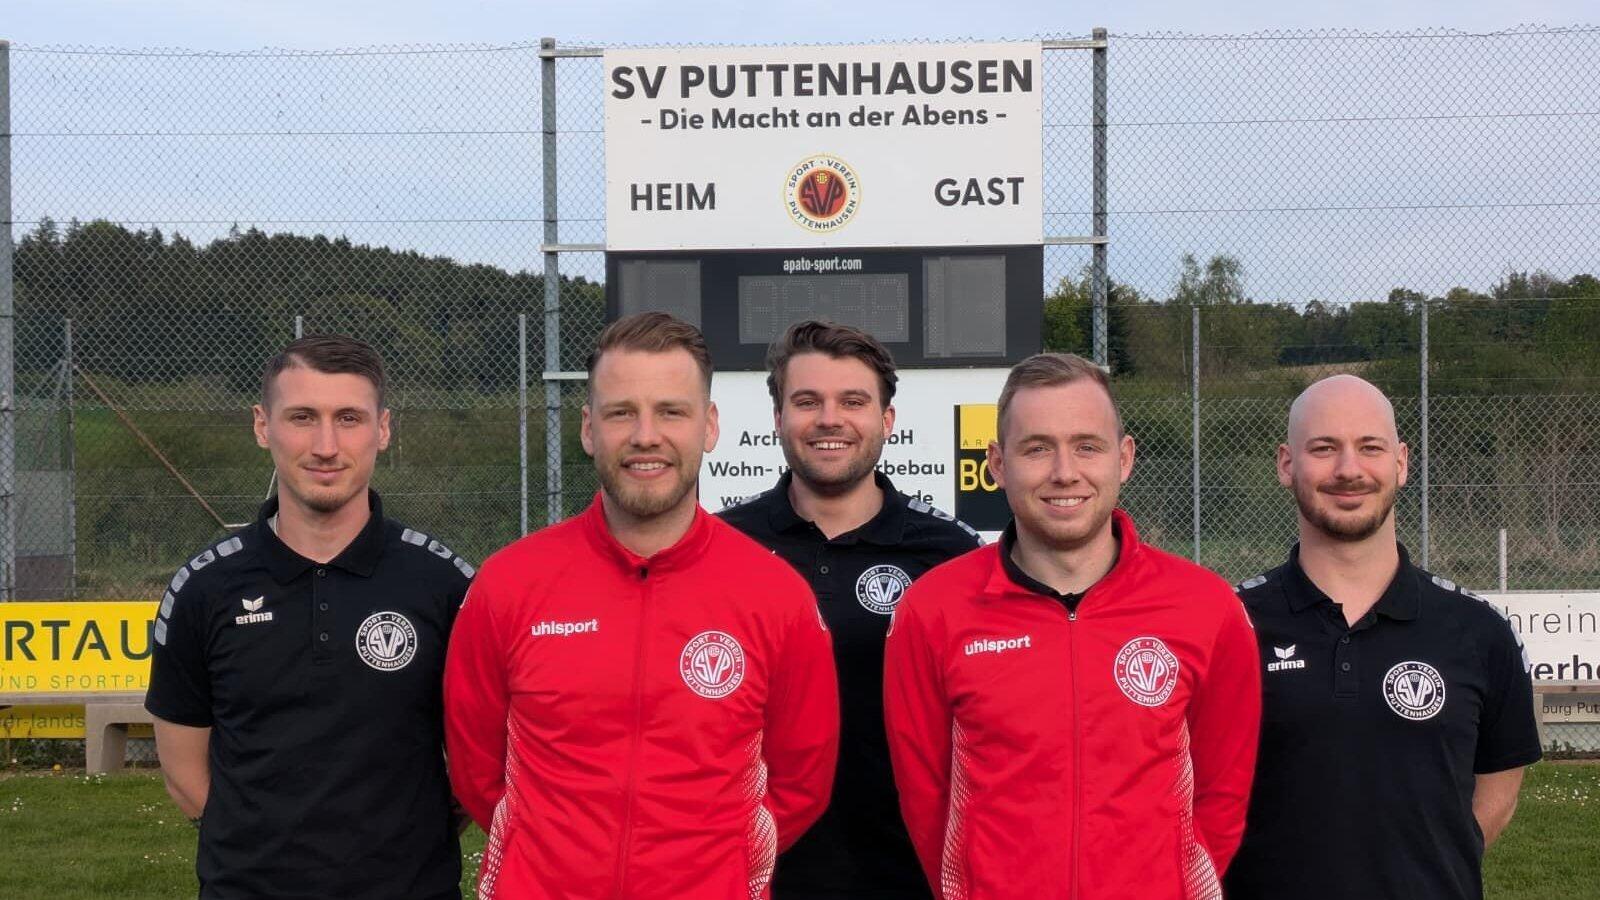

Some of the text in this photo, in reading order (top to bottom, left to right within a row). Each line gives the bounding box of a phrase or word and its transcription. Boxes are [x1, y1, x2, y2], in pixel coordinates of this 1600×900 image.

[611, 59, 1033, 99] SV PUTTENHAUSEN
[659, 108, 704, 130] Die
[711, 106, 799, 129] Macht
[806, 111, 839, 128] an
[848, 105, 895, 126] der
[901, 104, 989, 126] Abens
[789, 160, 815, 188] SPORT
[827, 159, 857, 189] VEREIN
[630, 183, 717, 211] HEIM
[800, 172, 844, 216] SVP
[934, 177, 1025, 206] GAST
[789, 200, 857, 229] PUTTENHAUSEN
[783, 256, 862, 274] apato-sport.com
[708, 461, 773, 477] Wohn-
[869, 576, 901, 604] SVP
[235, 611, 273, 625] erima
[361, 616, 381, 637] SPORT
[531, 618, 598, 637] uhlsport
[5, 619, 154, 660] RTAU
[370, 625, 404, 658] SVP
[685, 634, 709, 658] SPORT
[965, 634, 1031, 656] uhlsport
[1119, 641, 1142, 666] SPORT
[694, 647, 731, 685] SVP
[1130, 653, 1165, 692] SVP
[1267, 659, 1305, 672] erima
[1387, 664, 1408, 685] SPORT
[1529, 654, 1600, 680] erh
[1398, 674, 1433, 706] SVP
